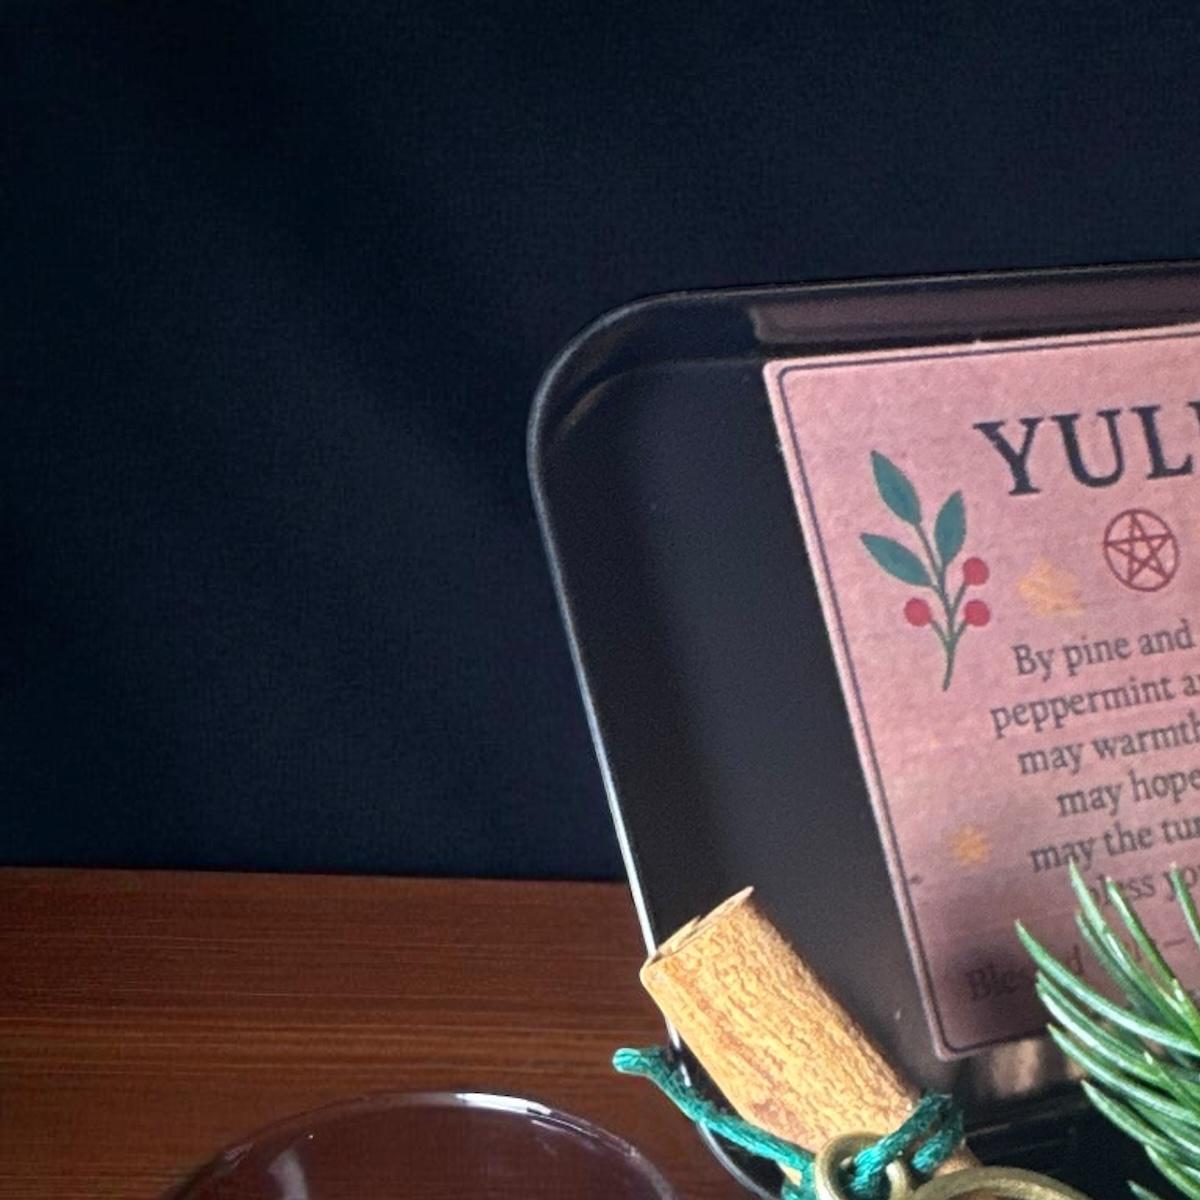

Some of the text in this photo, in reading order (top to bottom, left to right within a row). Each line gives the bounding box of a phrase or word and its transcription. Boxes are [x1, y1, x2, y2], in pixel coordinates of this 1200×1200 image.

[1011, 643, 1056, 681] By
[1062, 632, 1132, 677] pine
[1139, 618, 1195, 657] and
[990, 674, 1177, 740] peppermint
[1017, 742, 1085, 777] may
[1056, 784, 1122, 816] may
[1030, 839, 1097, 873] may
[1103, 822, 1153, 857] the
